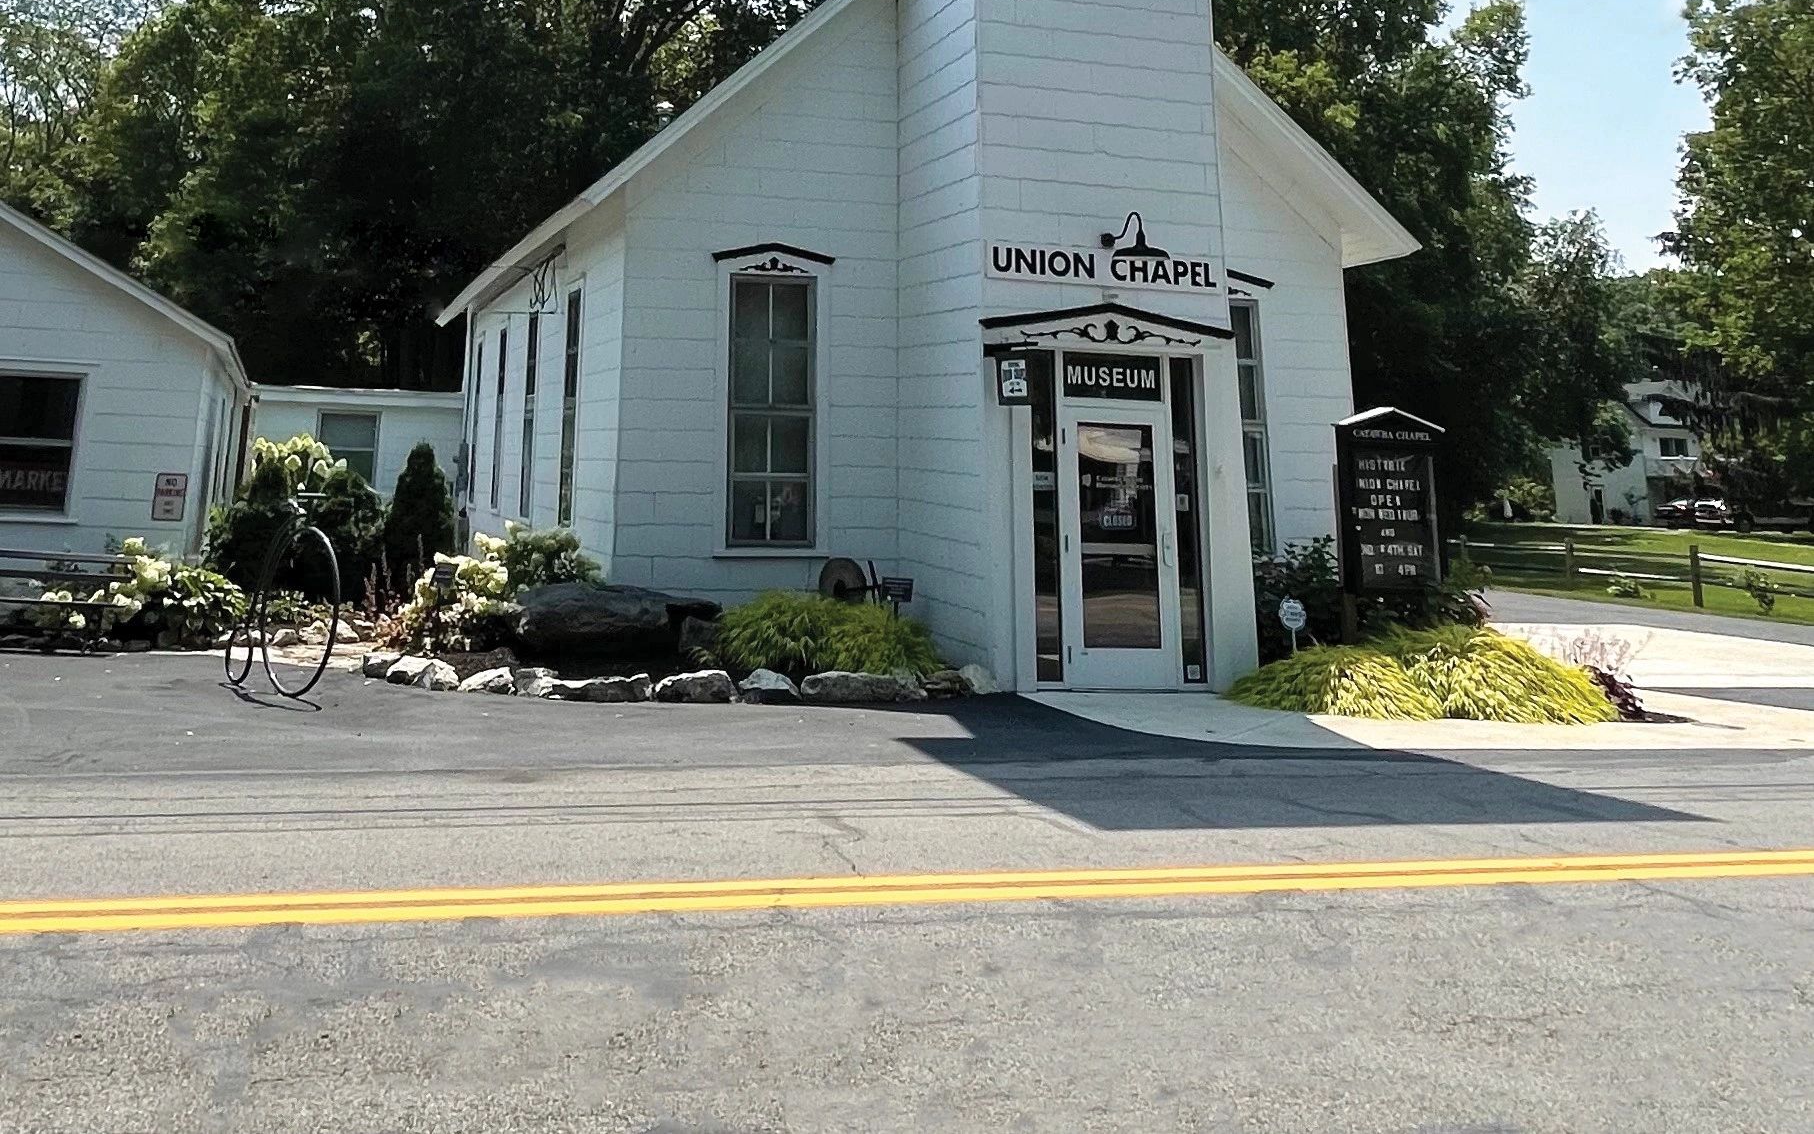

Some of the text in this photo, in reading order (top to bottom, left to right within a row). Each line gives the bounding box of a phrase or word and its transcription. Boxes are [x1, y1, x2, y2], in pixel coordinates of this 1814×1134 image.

[992, 246, 1217, 288] UNION CHAPEL
[1067, 365, 1156, 389] MUSEUM
[1396, 431, 1431, 441] CHAPEL
[165, 478, 178, 487] NO
[1370, 494, 1401, 506] OPEN
[1103, 515, 1133, 527] CLOSED
